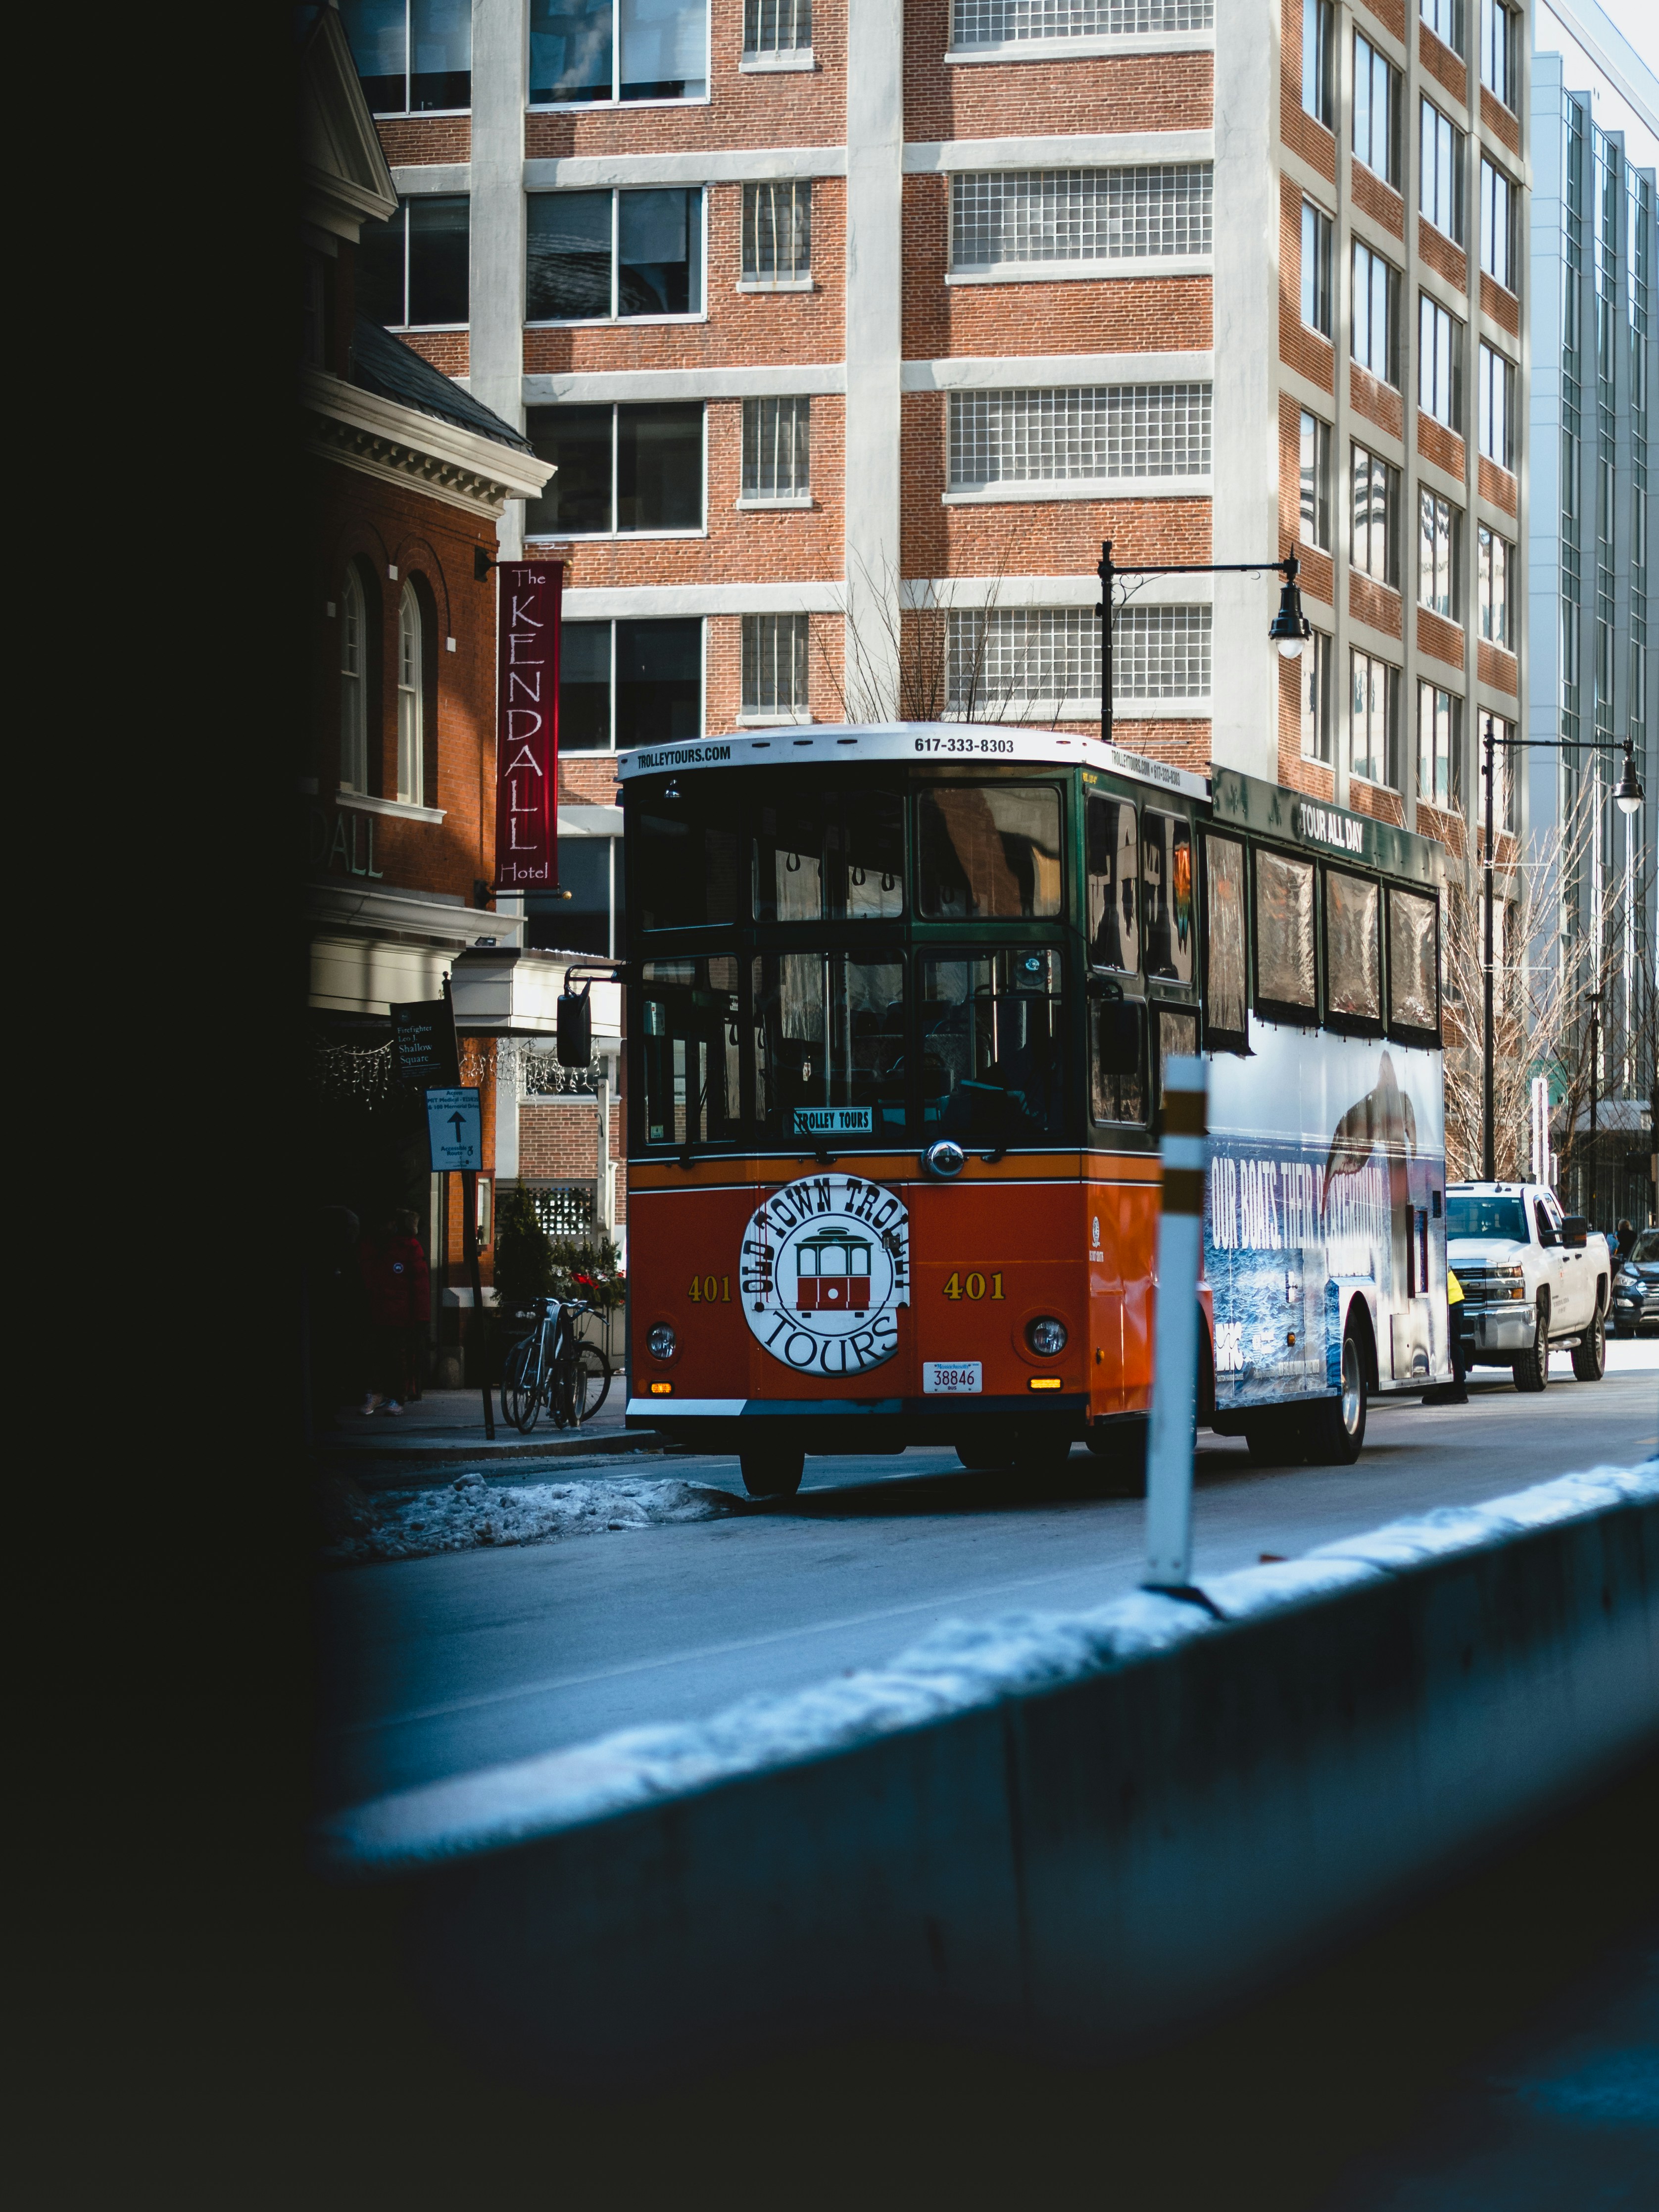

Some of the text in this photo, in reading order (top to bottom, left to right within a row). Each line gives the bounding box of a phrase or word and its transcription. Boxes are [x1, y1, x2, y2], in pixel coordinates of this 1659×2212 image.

[512, 569, 546, 586] The
[504, 595, 544, 850] KENDALL
[637, 746, 731, 769] TROLLEYTOURS.COM
[915, 738, 1014, 753] 617-333-8303
[1111, 750, 1180, 786] TROLLEYTOURS.COM 617-333-8303
[1300, 803, 1363, 854] TOUR ALL DAY
[500, 862, 548, 883] Hotel
[397, 1026, 432, 1034] Firefighter
[399, 1043, 432, 1053] Shallow
[400, 1055, 429, 1065] Square
[839, 1111, 869, 1129] TOURS
[753, 1177, 831, 1239] TOWN
[1212, 1156, 1238, 1250] OUR
[1240, 1159, 1281, 1250] BOATS.
[1281, 1163, 1314, 1249] THEIR
[742, 1240, 775, 1293] OLD
[688, 1276, 731, 1302] 401
[943, 1273, 1005, 1300] 401
[764, 1310, 898, 1374] TOURS
[934, 1370, 975, 1385] 38846
